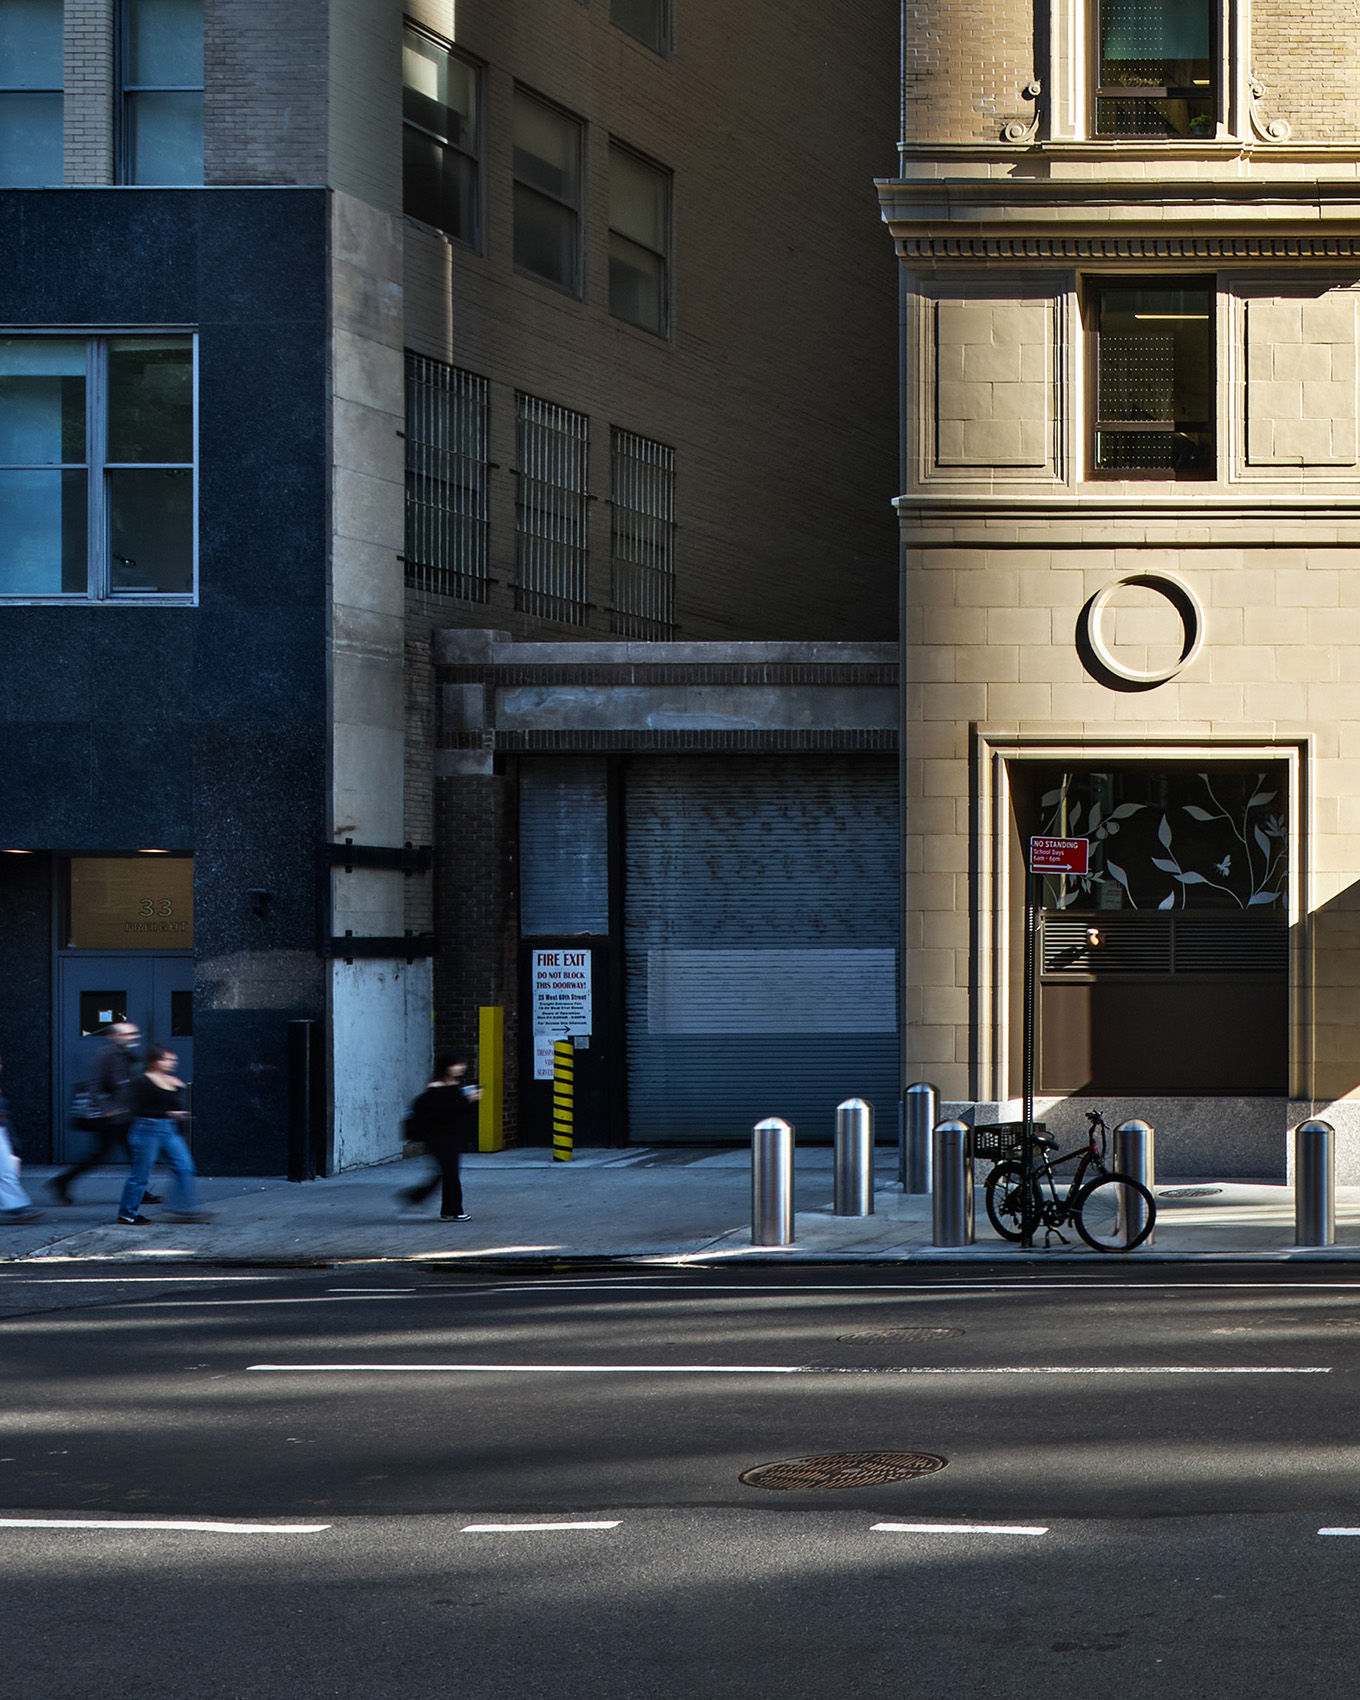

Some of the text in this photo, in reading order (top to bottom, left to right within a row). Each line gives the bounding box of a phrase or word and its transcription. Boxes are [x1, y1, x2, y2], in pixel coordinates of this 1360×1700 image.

[1033, 840, 1079, 849] NO STANDING
[139, 898, 173, 917] 33
[124, 921, 189, 933] FREIGHT
[537, 953, 586, 966] FIRE EXIT
[537, 971, 585, 979] DO NOT BLOCK
[536, 981, 587, 989] THIS DOORWAY!
